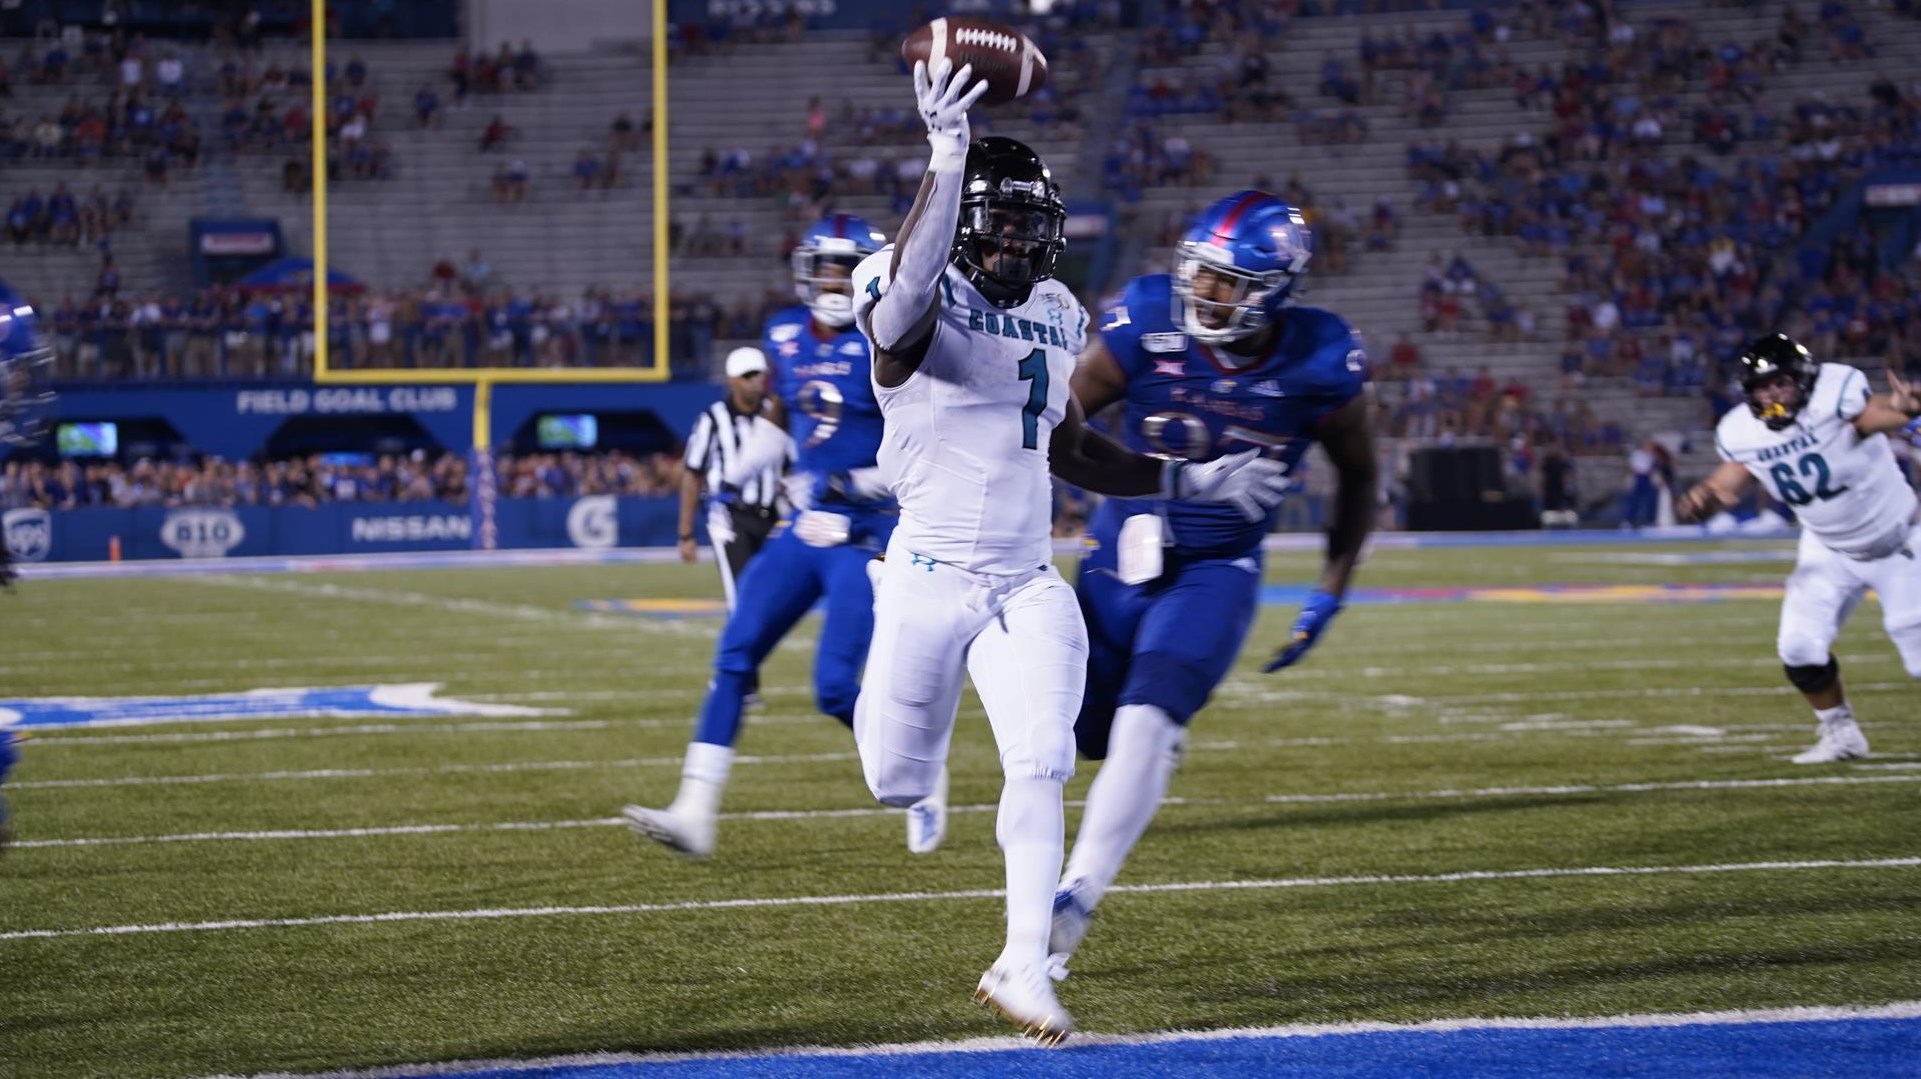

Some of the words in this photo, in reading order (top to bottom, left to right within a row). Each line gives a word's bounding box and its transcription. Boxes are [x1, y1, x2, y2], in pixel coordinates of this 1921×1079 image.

[237, 390, 309, 414] FIELD
[315, 388, 384, 413] GOAL
[389, 387, 457, 412] CLUB
[1018, 348, 1050, 450] 1
[1770, 452, 1849, 507] 62
[353, 515, 470, 541] NISSAN
